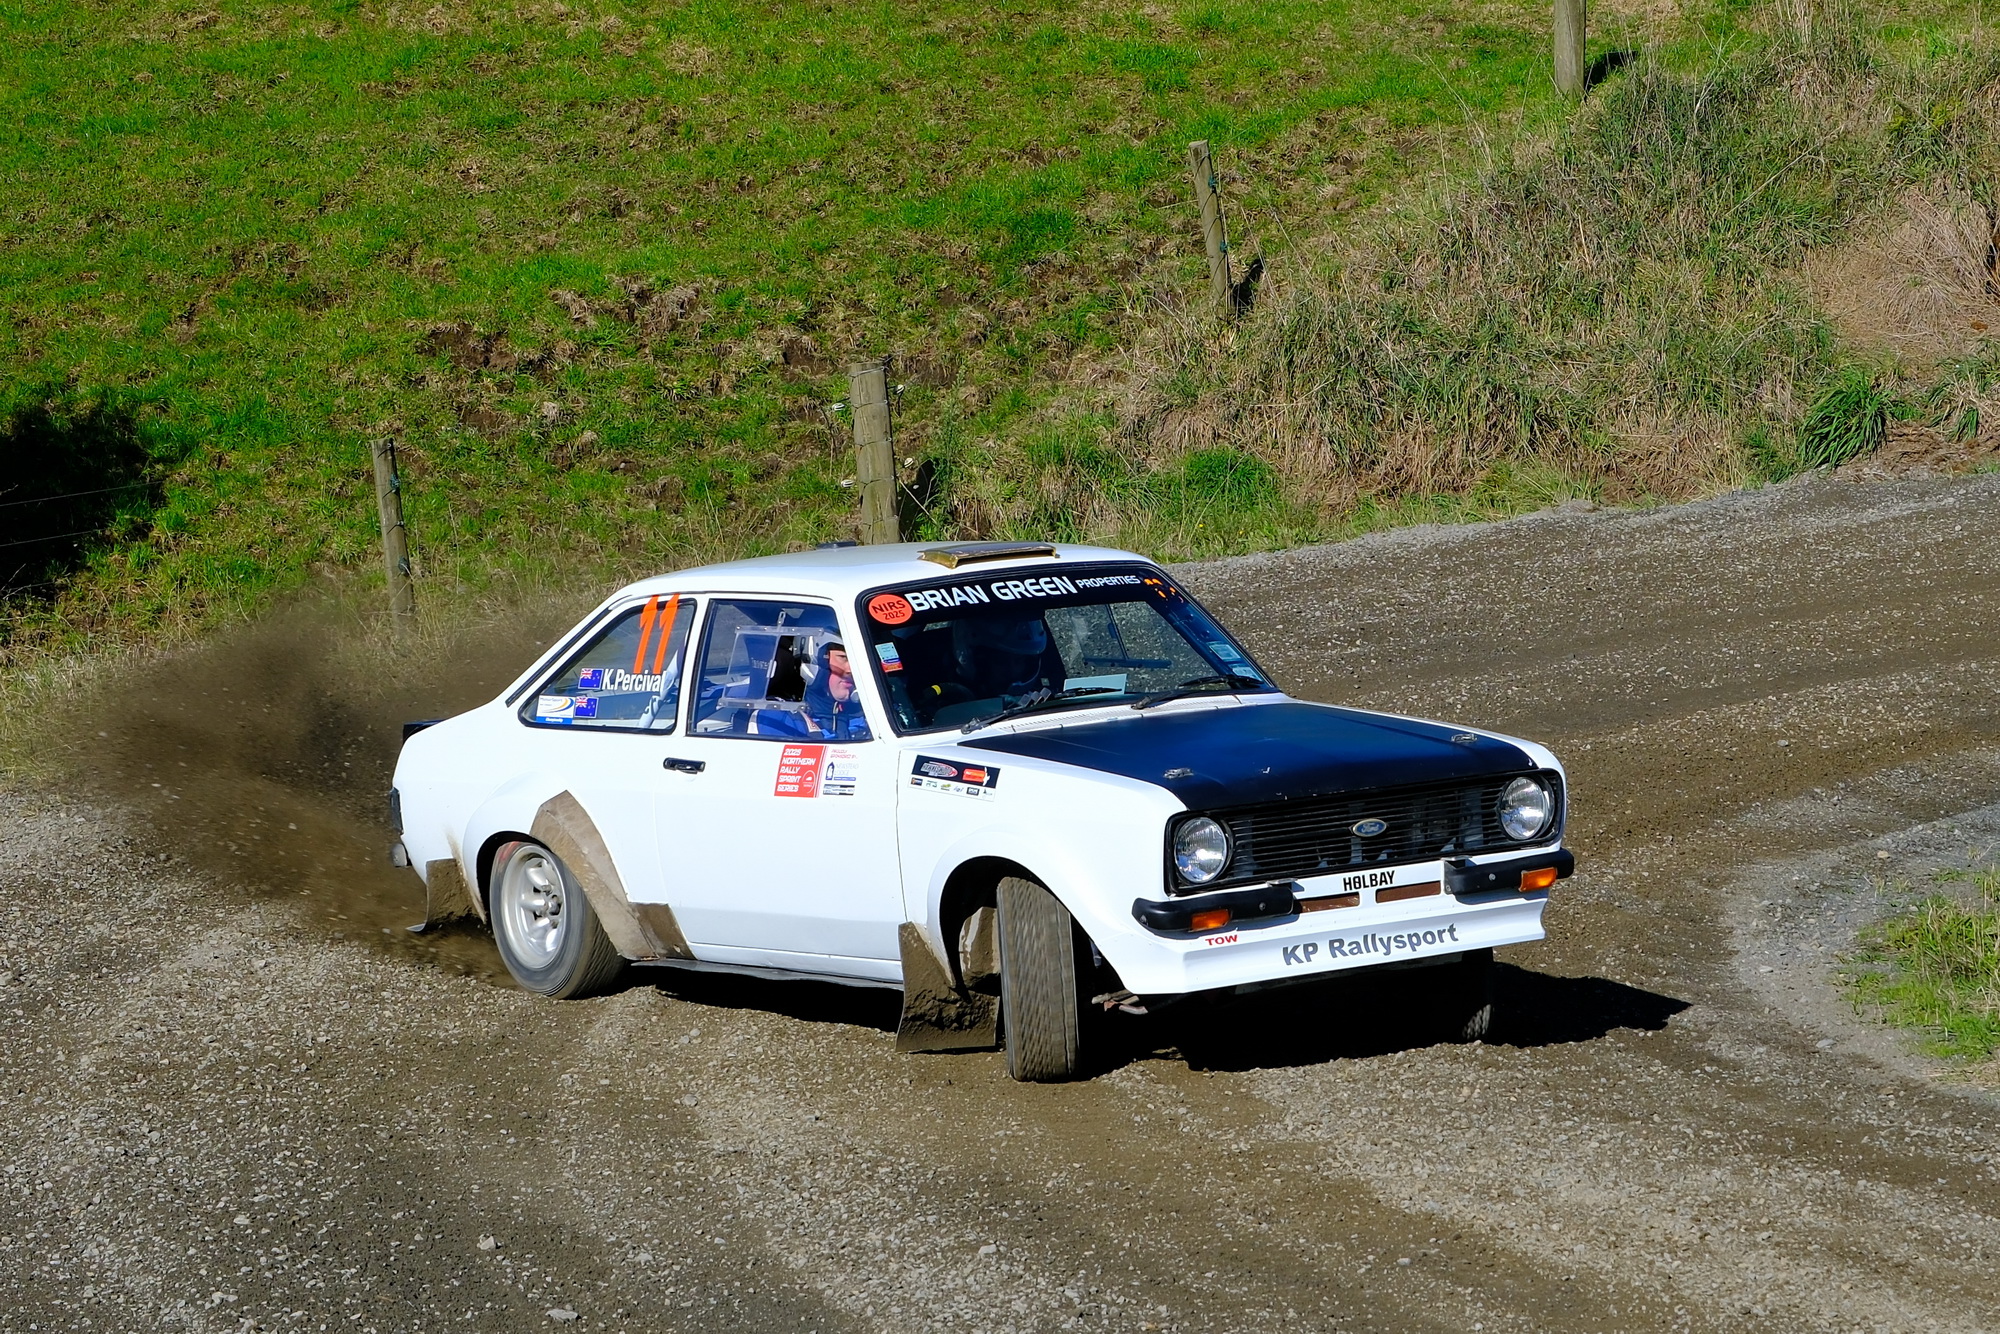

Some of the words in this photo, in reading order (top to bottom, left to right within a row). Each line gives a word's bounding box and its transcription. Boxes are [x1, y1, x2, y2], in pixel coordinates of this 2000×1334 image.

[904, 585, 990, 612] BRIAN
[990, 575, 1078, 601] GREEN
[1075, 575, 1141, 589] PROPERTIES
[872, 599, 906, 614] NIRS
[883, 610, 906, 620] 2025
[633, 593, 680, 674] 11
[781, 757, 817, 766] NORTHERN
[779, 766, 801, 774] RALLY
[778, 775, 802, 783] SPRINT
[777, 784, 799, 792] SERIES
[1205, 934, 1239, 947] TOW
[1282, 943, 1319, 966] KP
[1328, 922, 1459, 958] Rallysport
